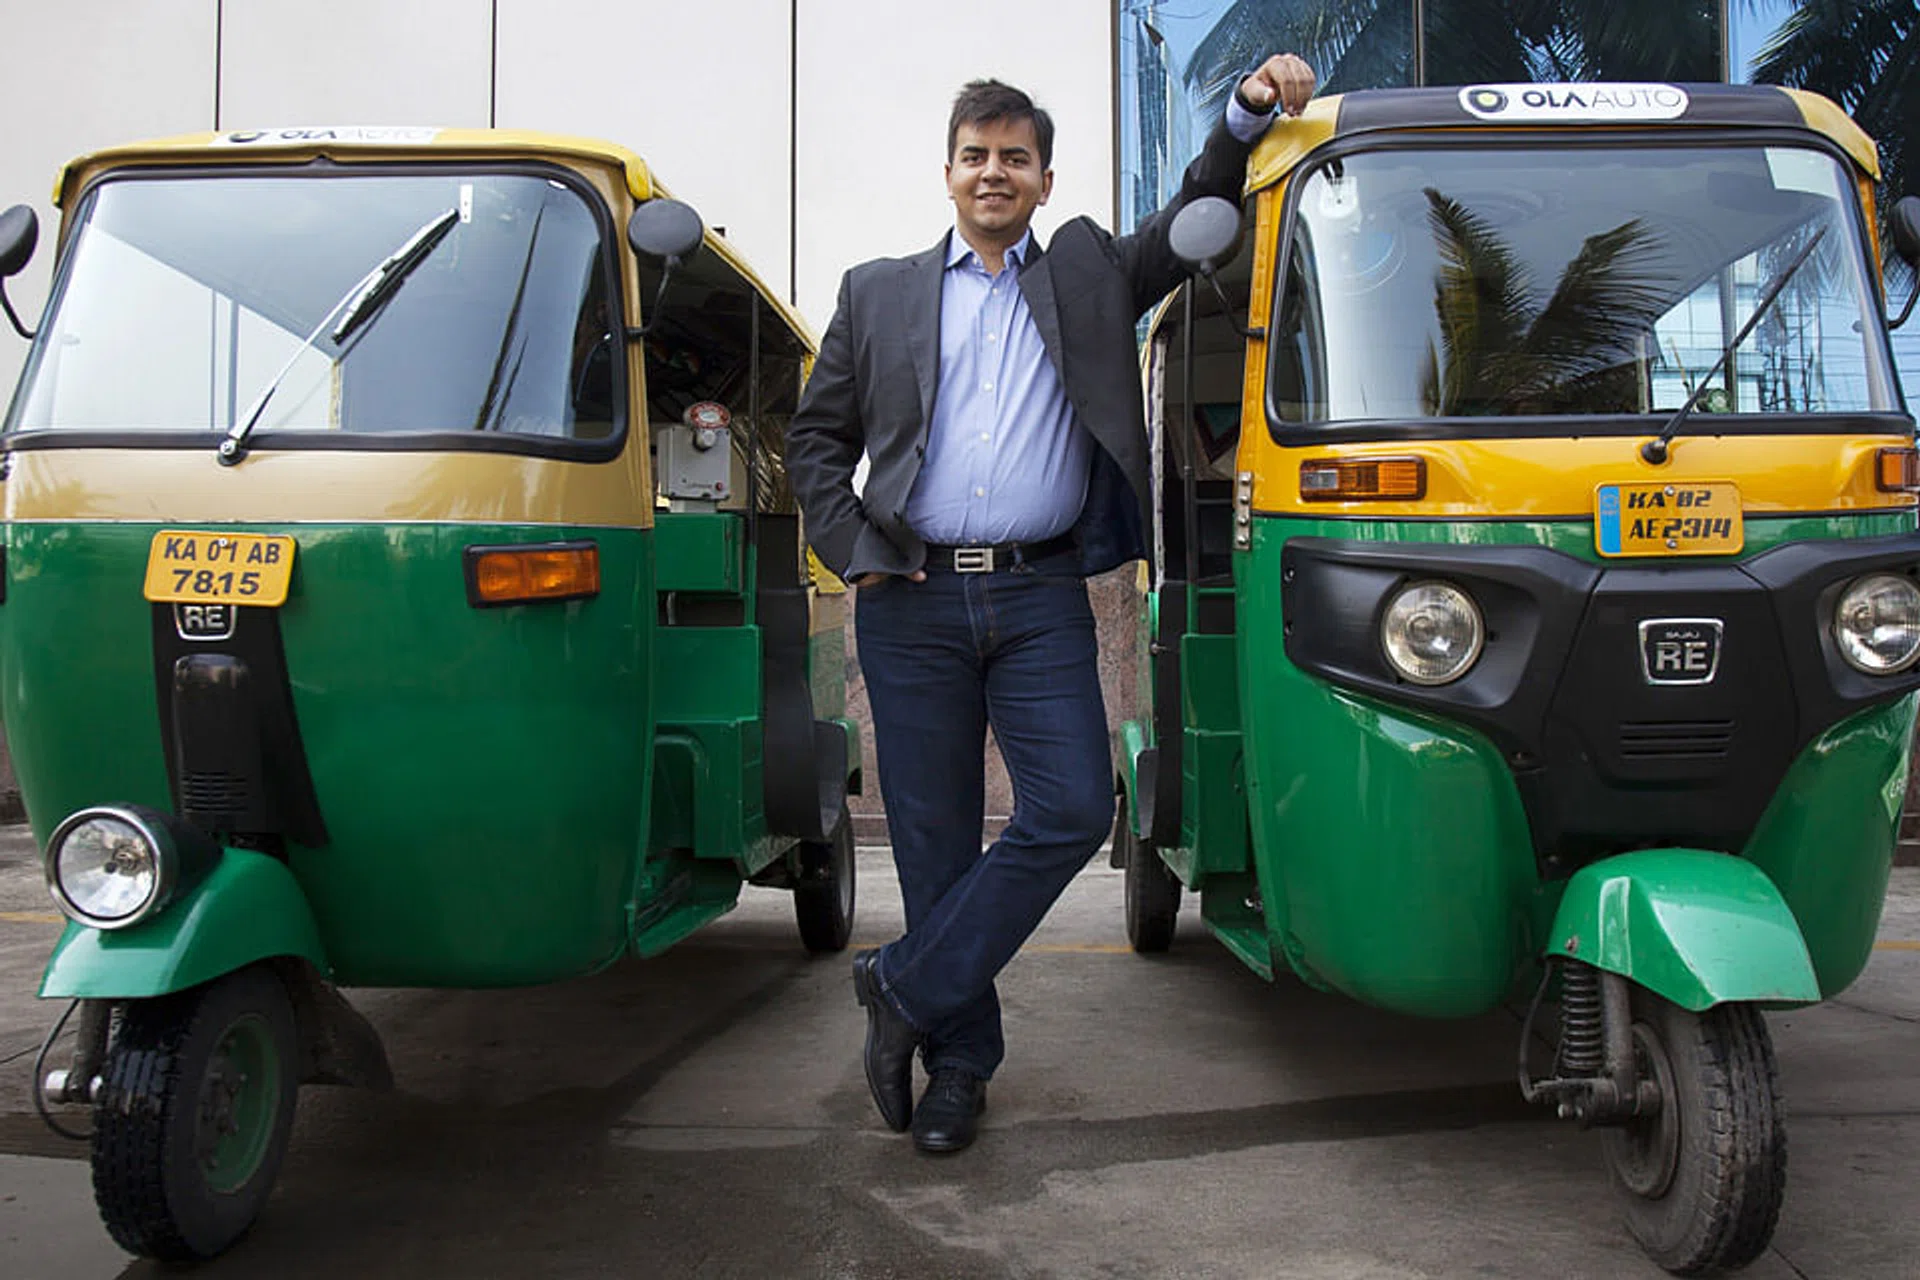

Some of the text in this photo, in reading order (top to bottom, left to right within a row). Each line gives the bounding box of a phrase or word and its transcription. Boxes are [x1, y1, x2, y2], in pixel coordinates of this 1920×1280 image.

[1628, 492, 1666, 509] KA
[164, 538, 280, 564] KA 01 AB
[172, 569, 260, 595] 7815
[183, 605, 225, 629] RE
[1656, 642, 1707, 671] RE
